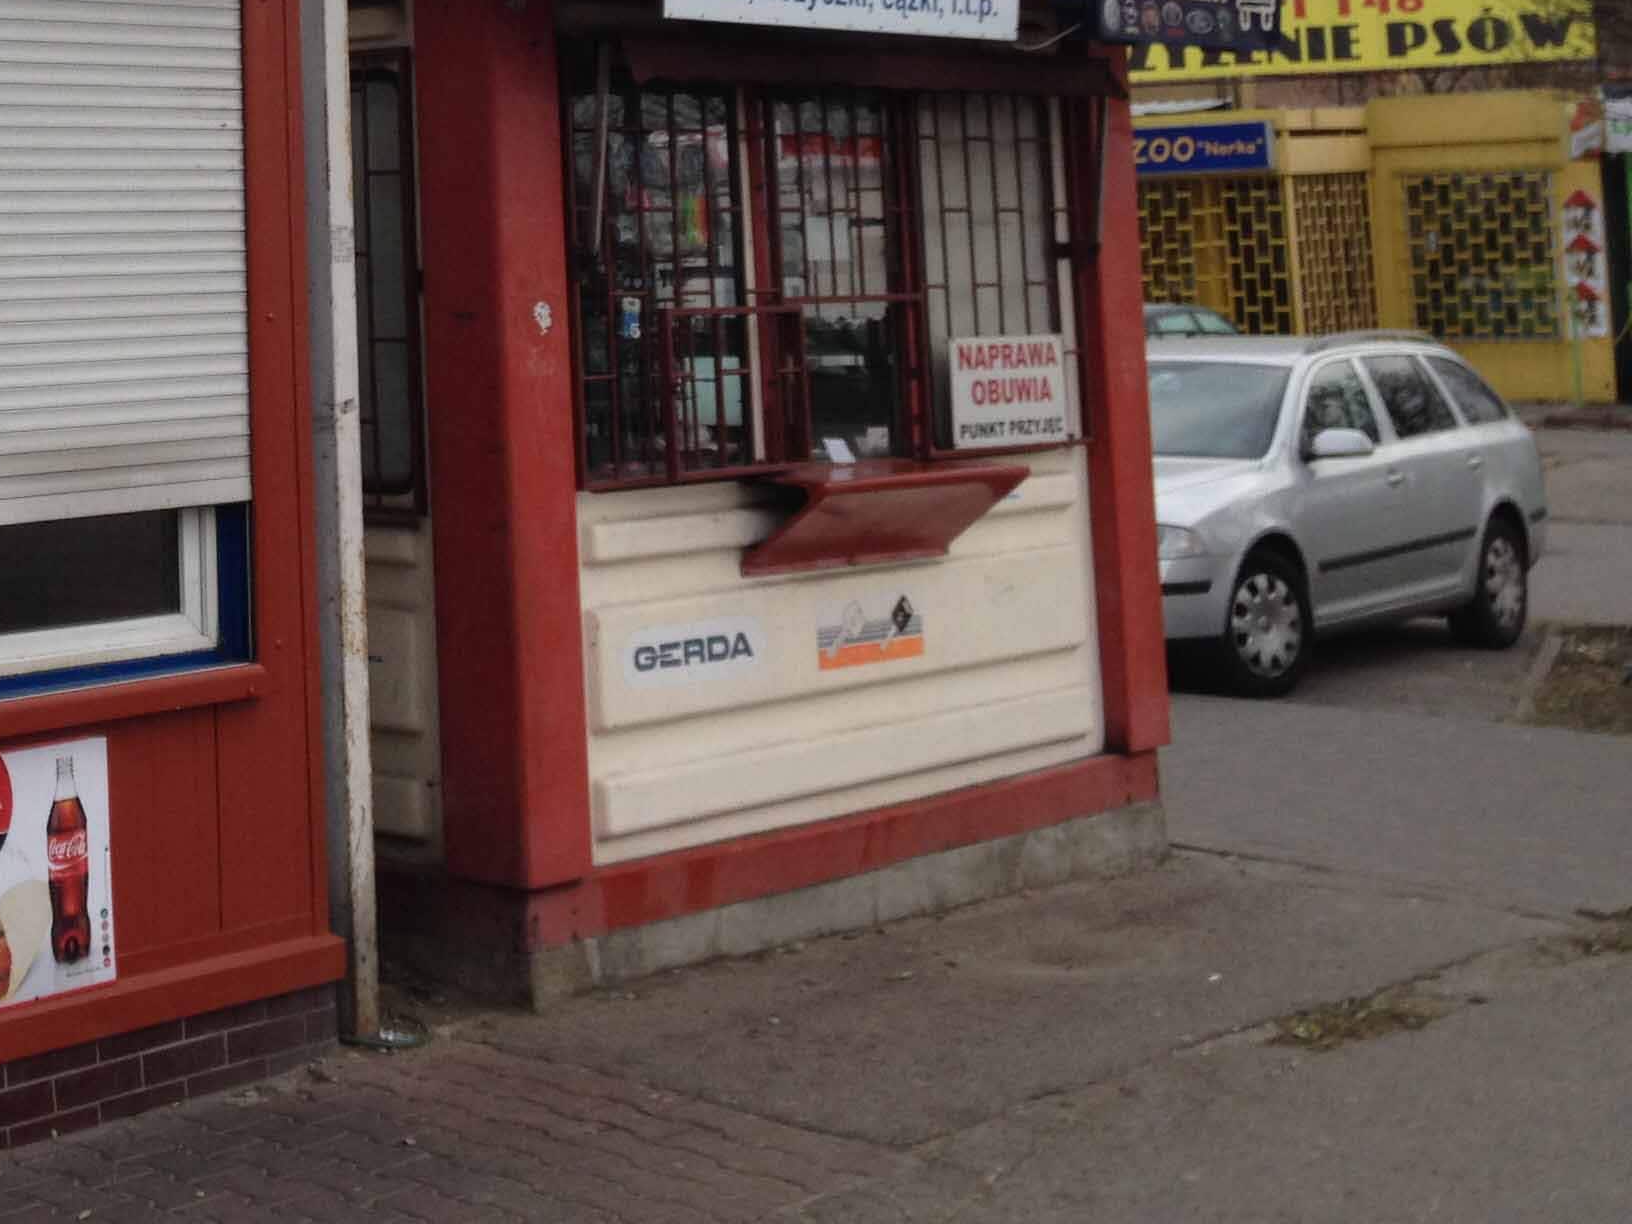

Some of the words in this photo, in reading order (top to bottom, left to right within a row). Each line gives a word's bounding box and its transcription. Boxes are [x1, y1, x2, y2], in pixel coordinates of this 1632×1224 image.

[1386, 7, 1570, 57] PSÓW
[958, 342, 1057, 371] NAPRAWA
[971, 376, 1053, 406] OBUWIA
[960, 420, 1007, 440] PUNKT
[633, 631, 754, 672] GERDA
